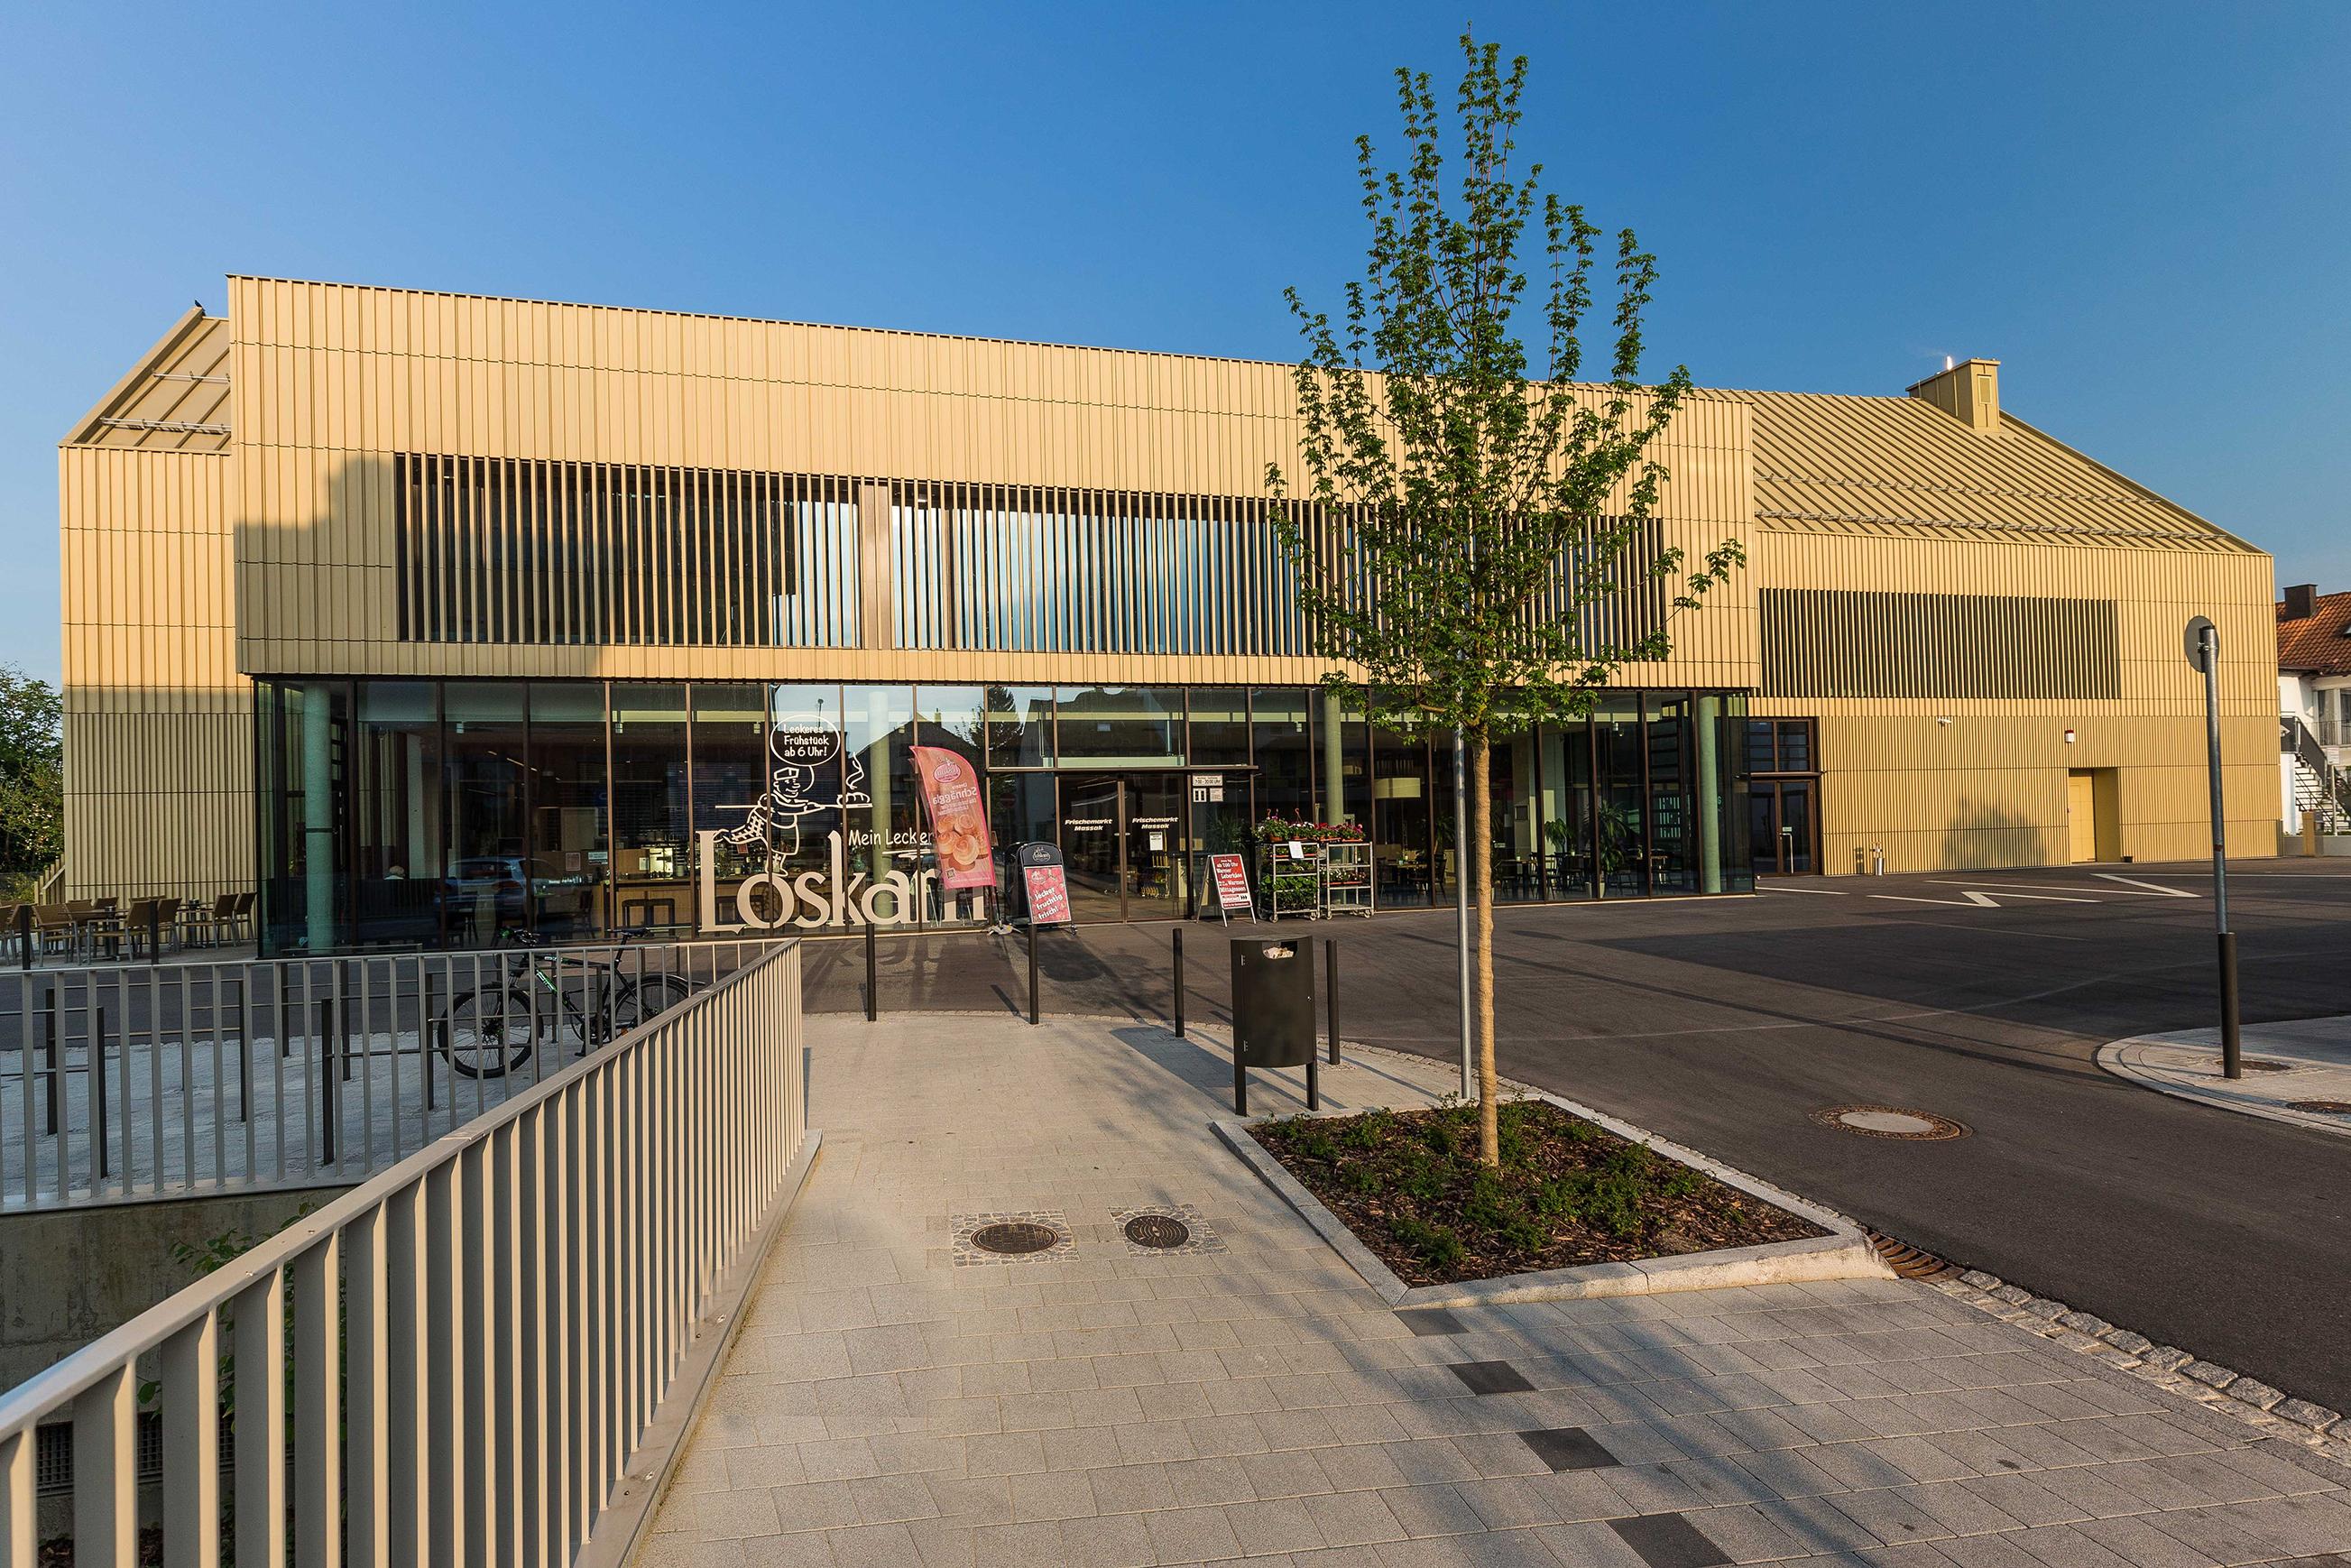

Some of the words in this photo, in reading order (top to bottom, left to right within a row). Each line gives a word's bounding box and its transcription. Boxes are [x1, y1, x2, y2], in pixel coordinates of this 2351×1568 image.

[783, 724, 824, 733] Leckeres
[784, 734, 829, 745] Frühstück
[784, 746, 796, 757] ab
[797, 747, 806, 757] 6
[807, 746, 827, 757] Uhr!
[848, 829, 881, 846] Mein
[1036, 894, 1064, 910] fruchtig
[1038, 905, 1059, 920] frisch!
